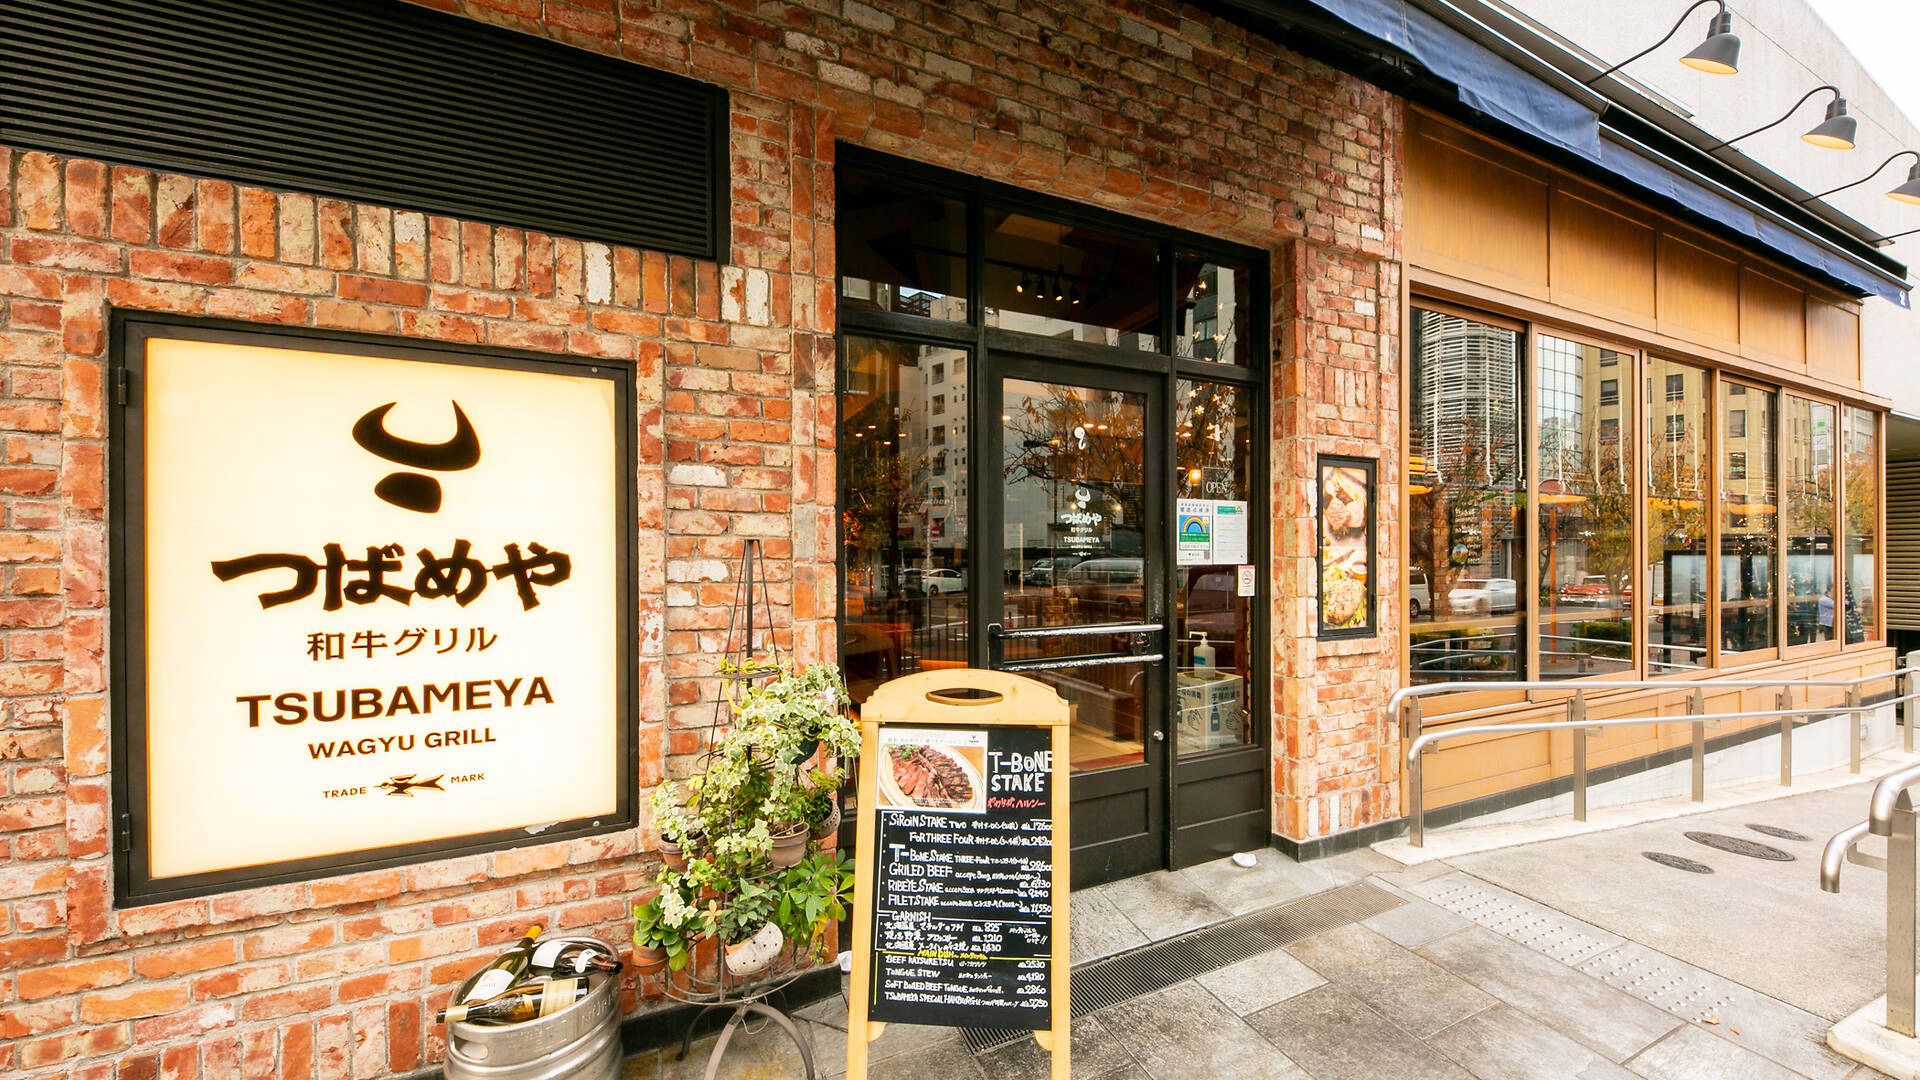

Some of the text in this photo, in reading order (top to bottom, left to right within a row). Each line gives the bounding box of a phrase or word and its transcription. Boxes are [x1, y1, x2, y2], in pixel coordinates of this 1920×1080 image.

[1206, 481, 1227, 494] OPEN
[211, 539, 571, 611] つばめや
[307, 626, 499, 661] 和牛グリル
[236, 676, 554, 728] TSUBAMEYA
[308, 727, 497, 760] WAGYU GRILL
[323, 772, 485, 798] TRADE MARK
[991, 773, 1045, 792] STAKE
[926, 864, 953, 878] BEEF
[892, 910, 931, 922] GARNISH
[918, 969, 940, 978] STEW
